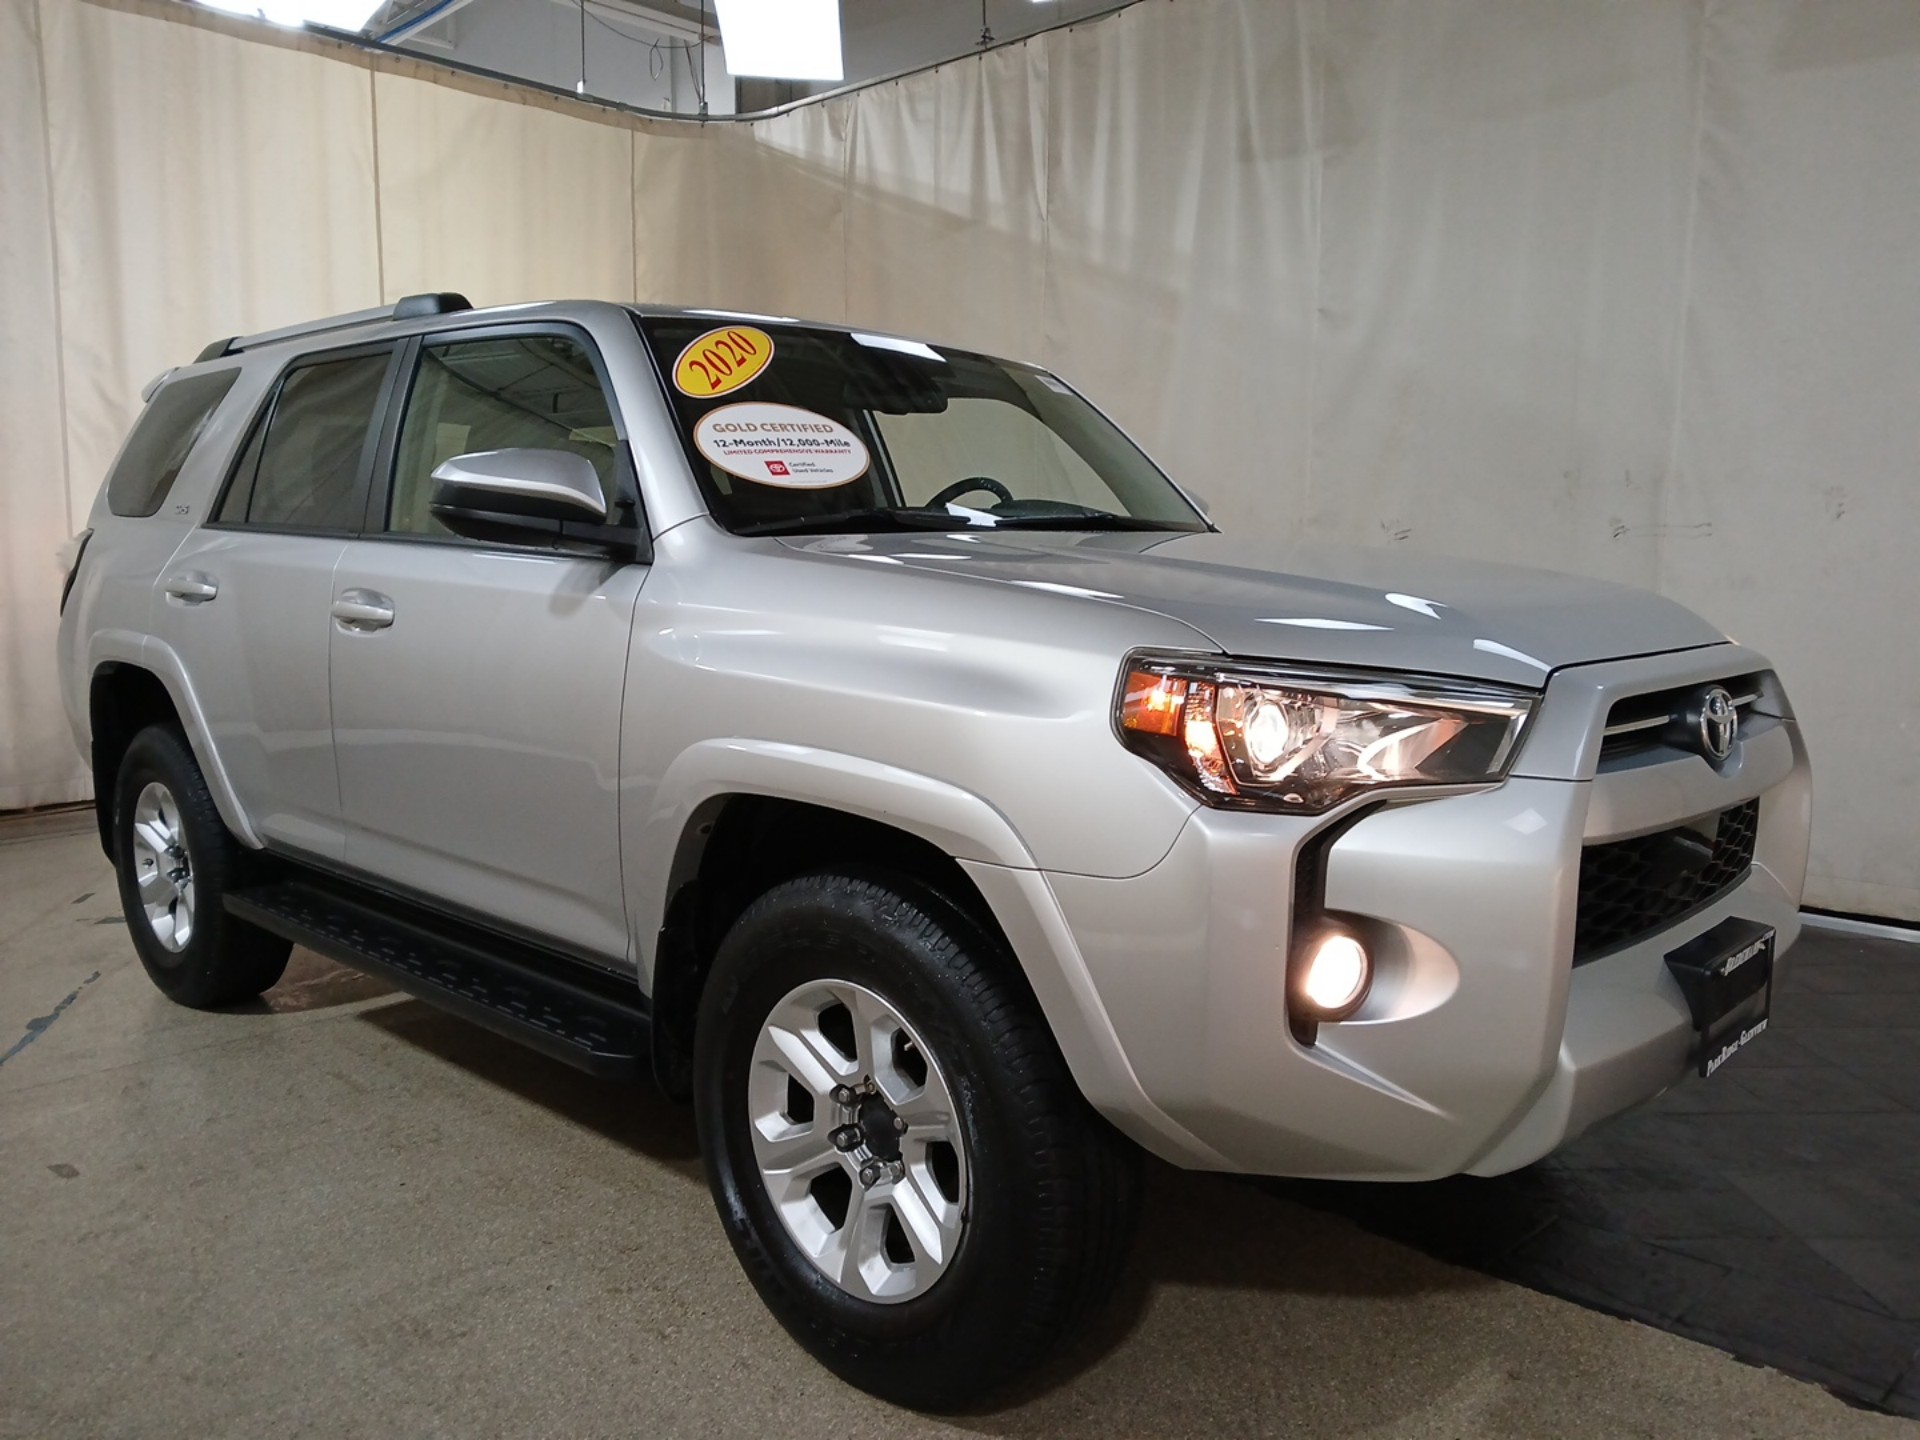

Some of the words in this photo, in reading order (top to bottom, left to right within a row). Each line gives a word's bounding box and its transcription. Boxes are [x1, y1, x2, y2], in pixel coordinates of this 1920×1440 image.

[688, 330, 757, 390] 2020
[712, 423, 758, 433] GOLD
[760, 423, 833, 433] CERTIFIED
[713, 437, 851, 448] 12-Month/12,000-Mile
